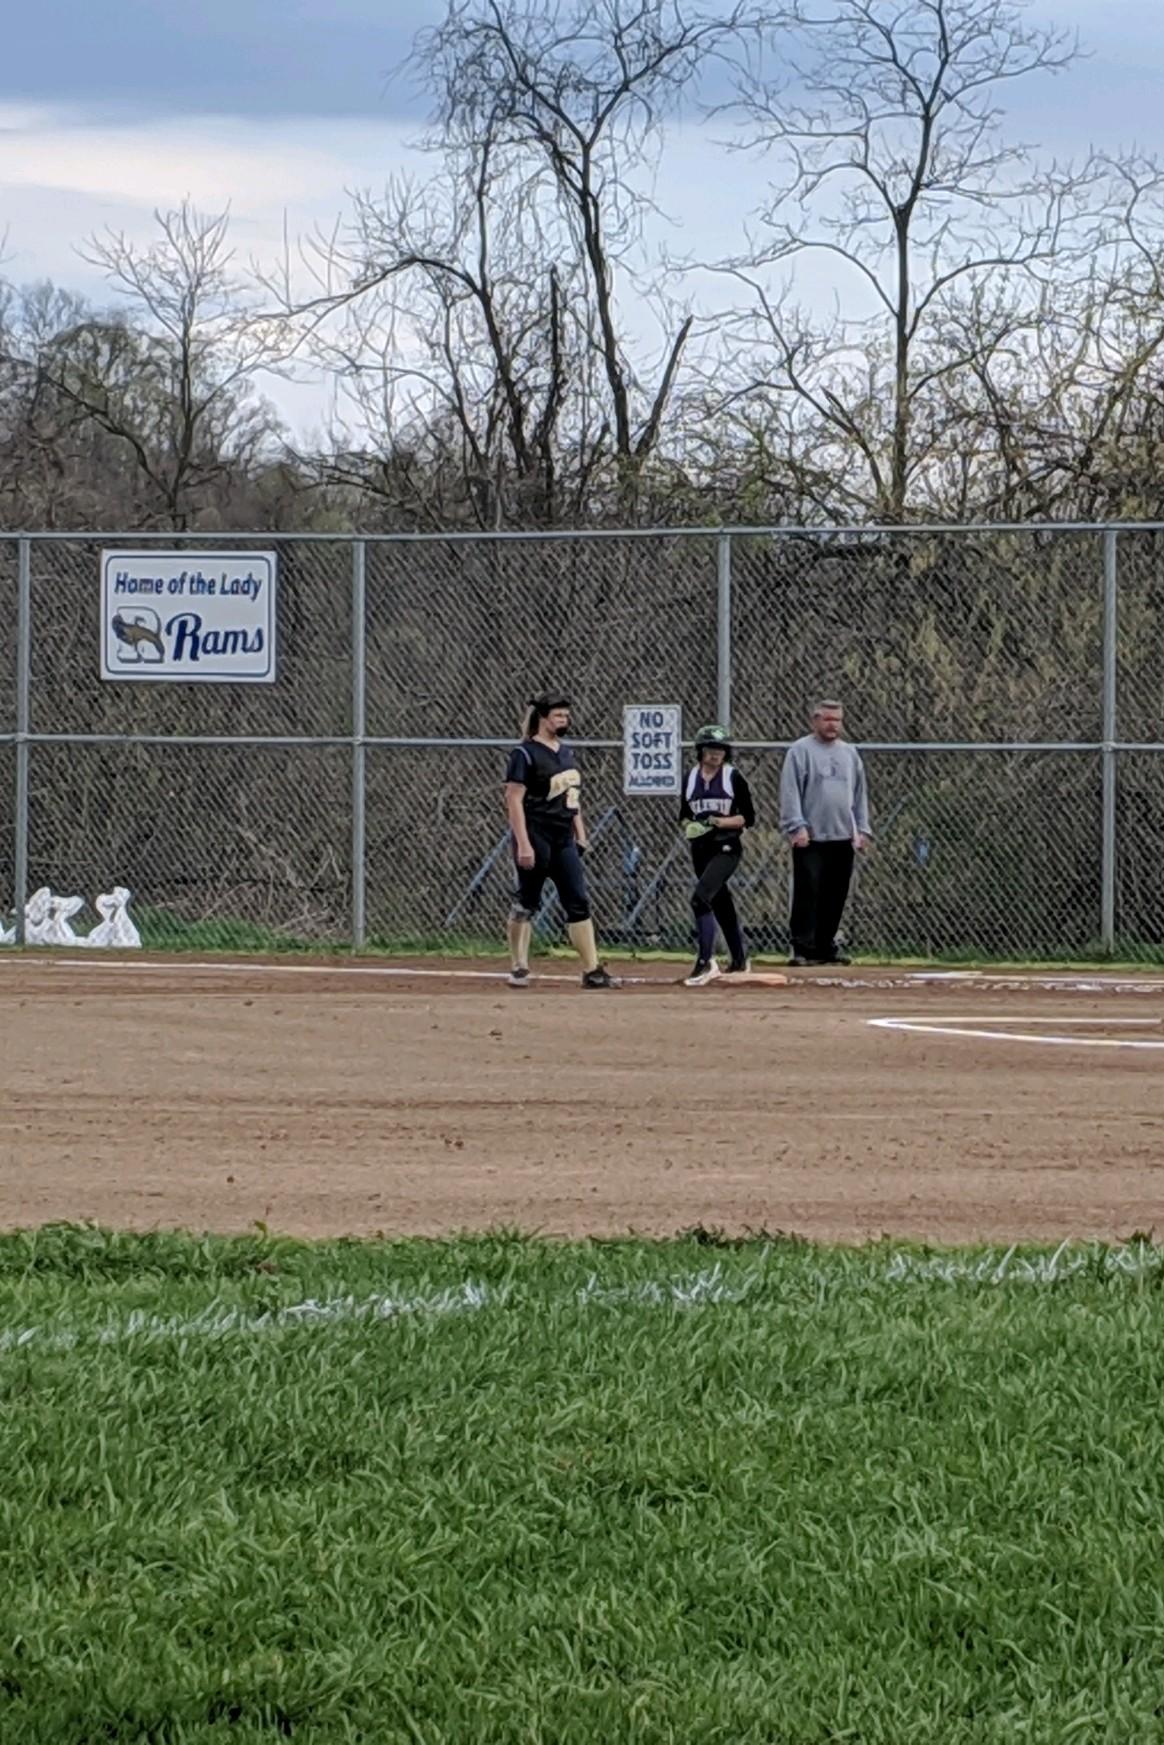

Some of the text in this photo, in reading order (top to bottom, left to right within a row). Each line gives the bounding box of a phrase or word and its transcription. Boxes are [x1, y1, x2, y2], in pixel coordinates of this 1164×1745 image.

[114, 571, 262, 602] Home of the Lady
[165, 612, 264, 662] Rams
[640, 711, 664, 728] NO
[632, 732, 673, 749] SOFT
[631, 753, 673, 770] TOSS
